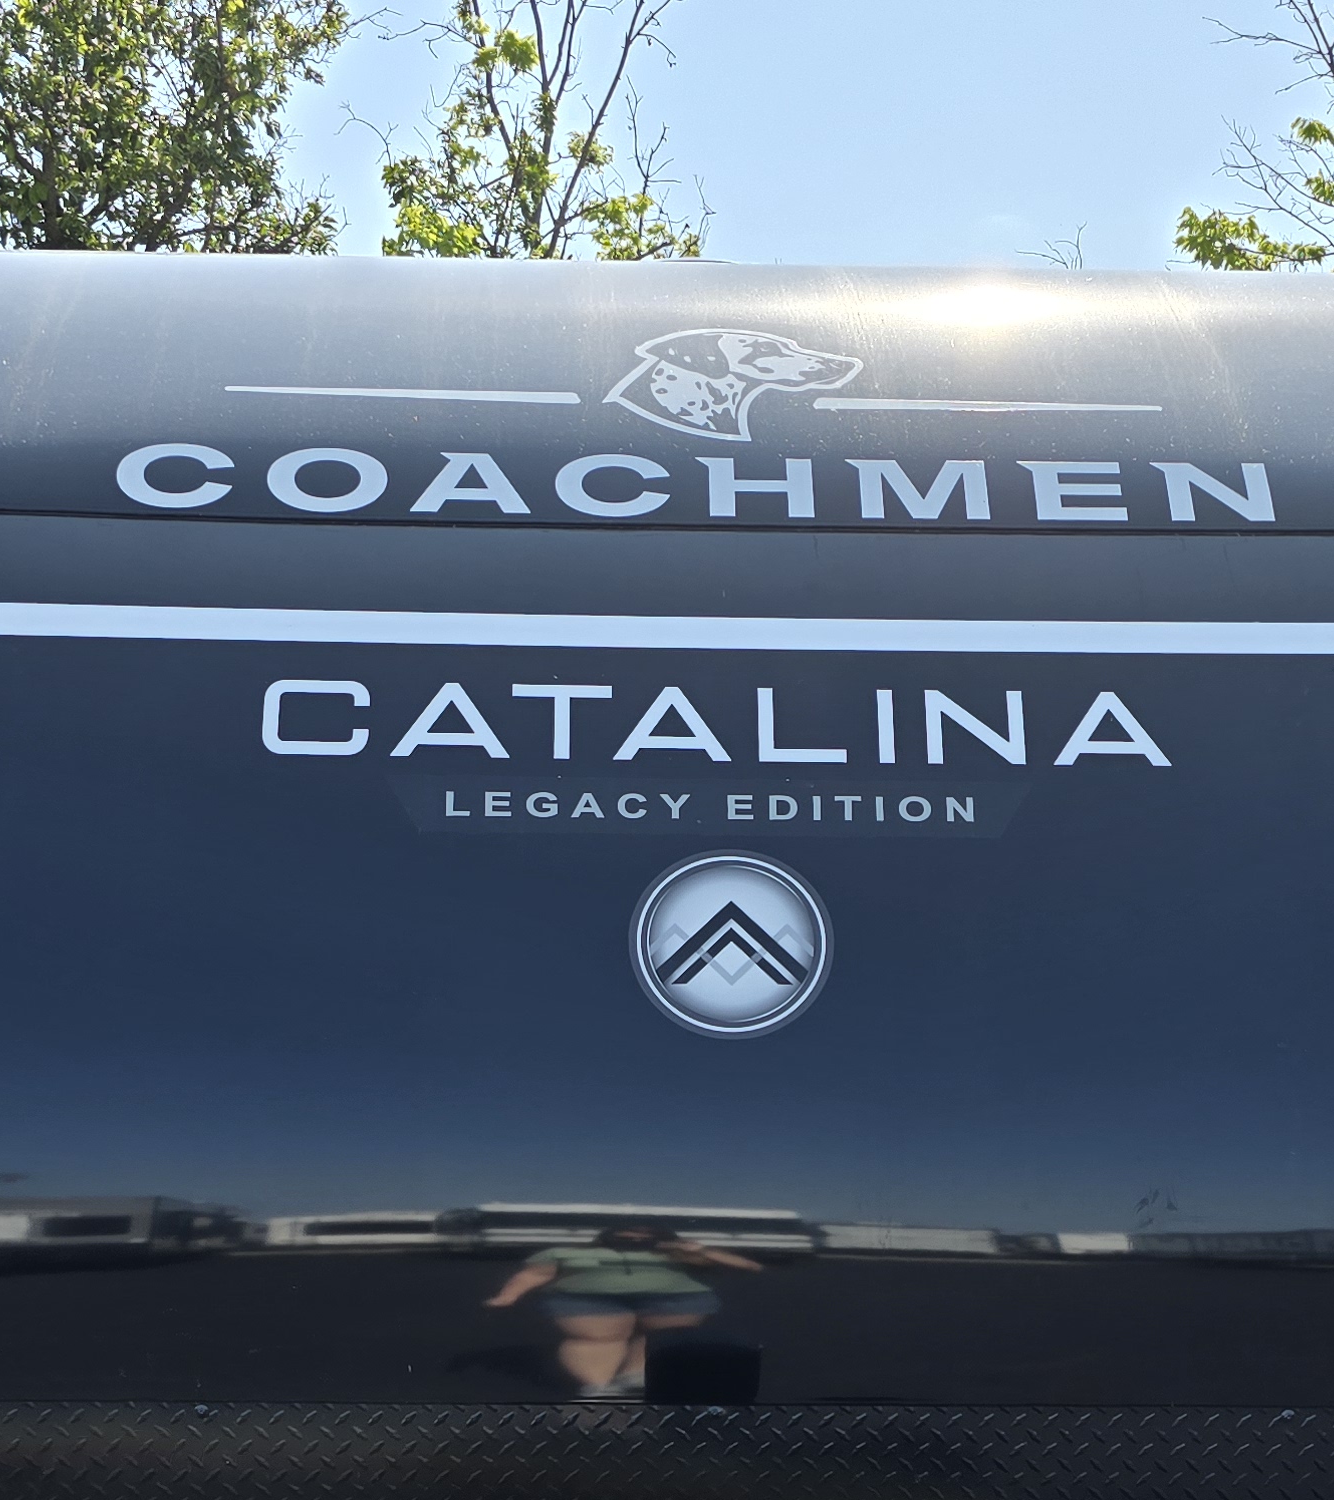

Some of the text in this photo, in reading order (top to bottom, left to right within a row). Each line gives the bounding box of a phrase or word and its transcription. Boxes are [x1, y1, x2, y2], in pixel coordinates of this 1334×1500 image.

[115, 442, 1276, 522] COACHMEN
[261, 678, 1173, 768] CATALINA
[444, 789, 977, 824] LEGACY EDITION
